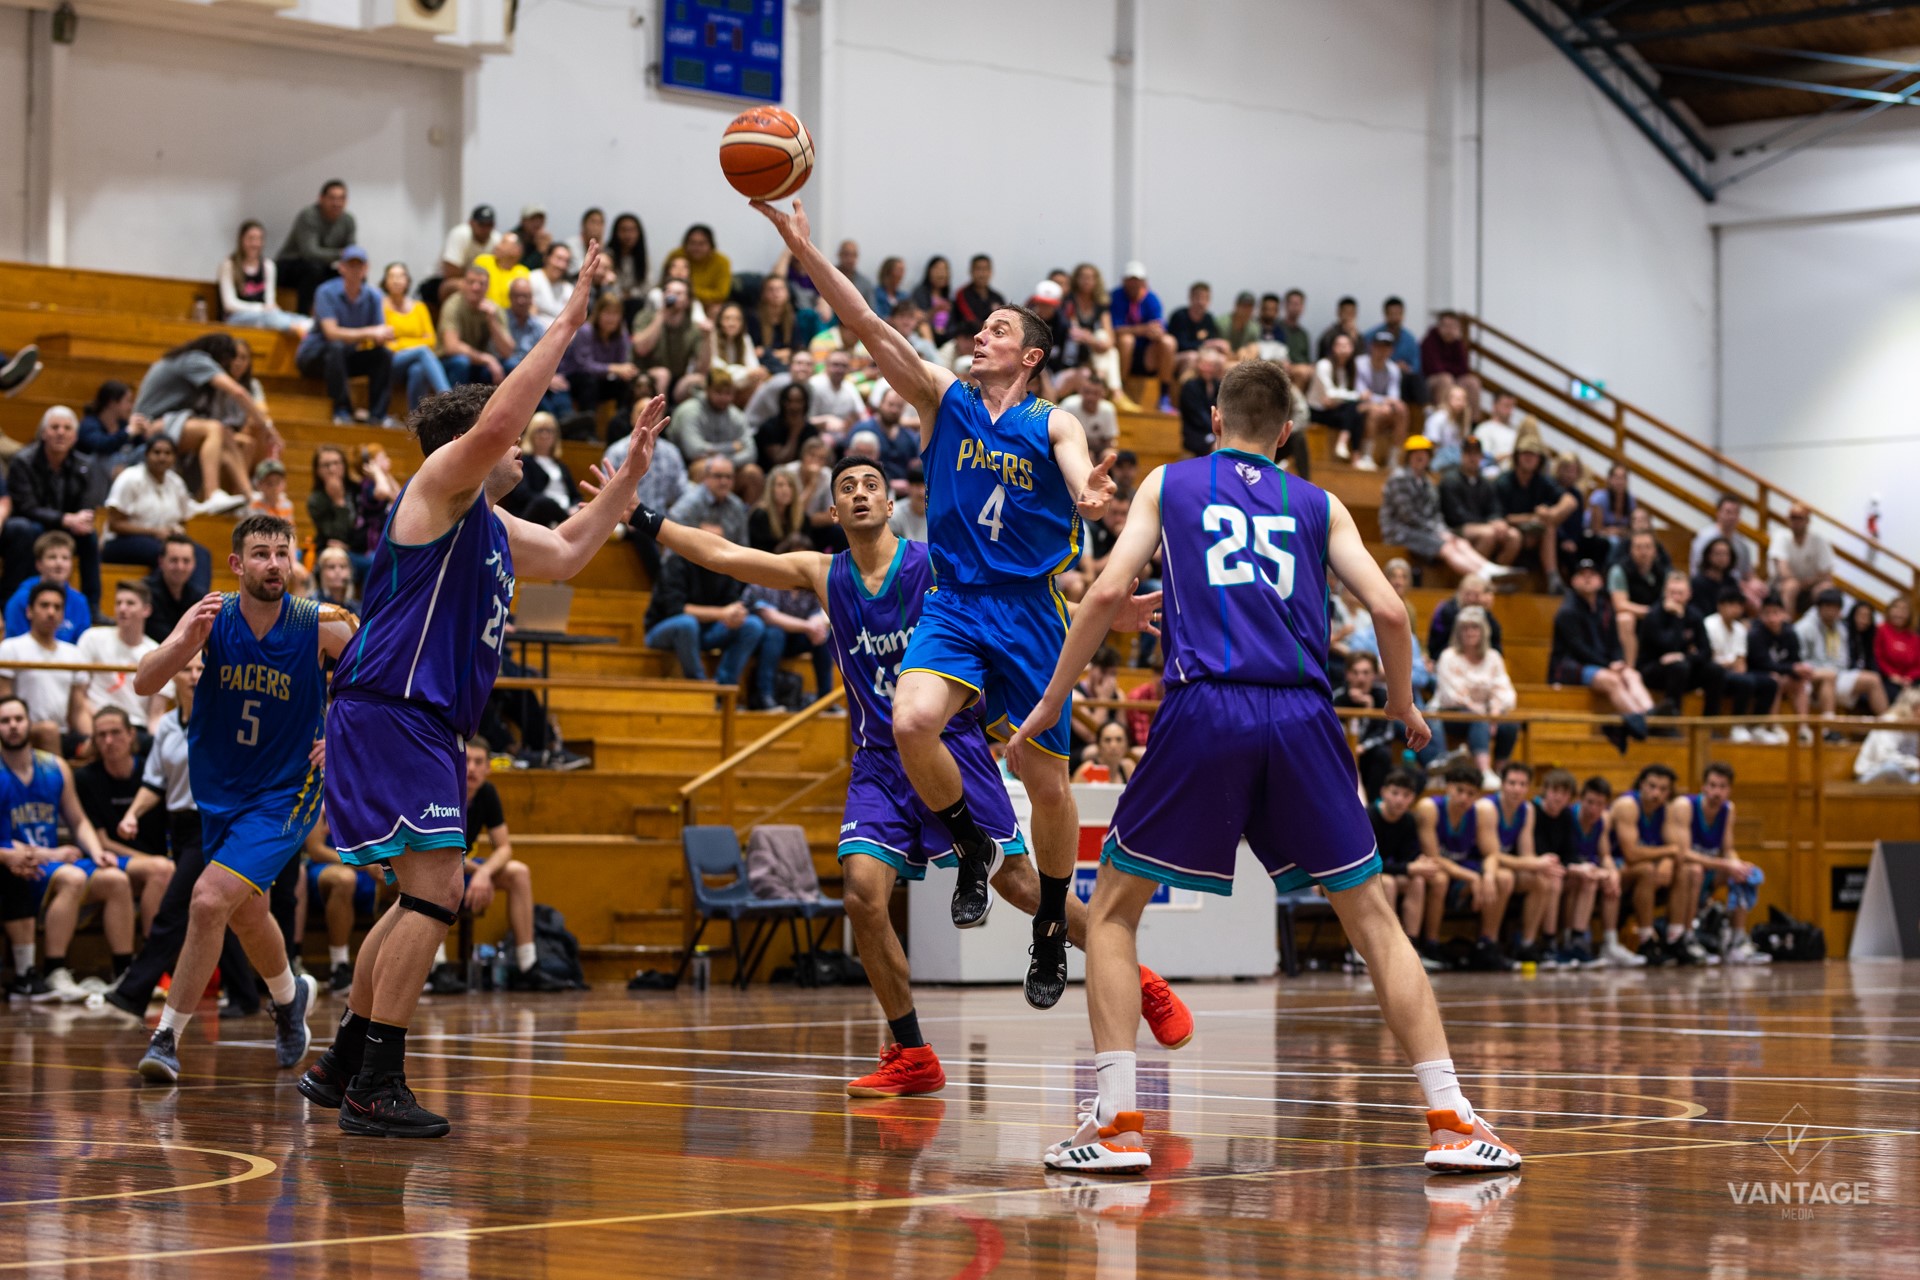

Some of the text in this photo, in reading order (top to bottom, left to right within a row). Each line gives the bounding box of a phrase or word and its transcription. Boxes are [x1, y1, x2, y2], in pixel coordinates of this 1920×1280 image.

[956, 438, 1033, 492] PACERS
[977, 484, 1006, 542] 4
[1201, 503, 1297, 601] 25
[849, 621, 920, 656] Atam
[220, 663, 291, 701] PACERS
[873, 662, 902, 708] 4
[236, 699, 261, 746] 5
